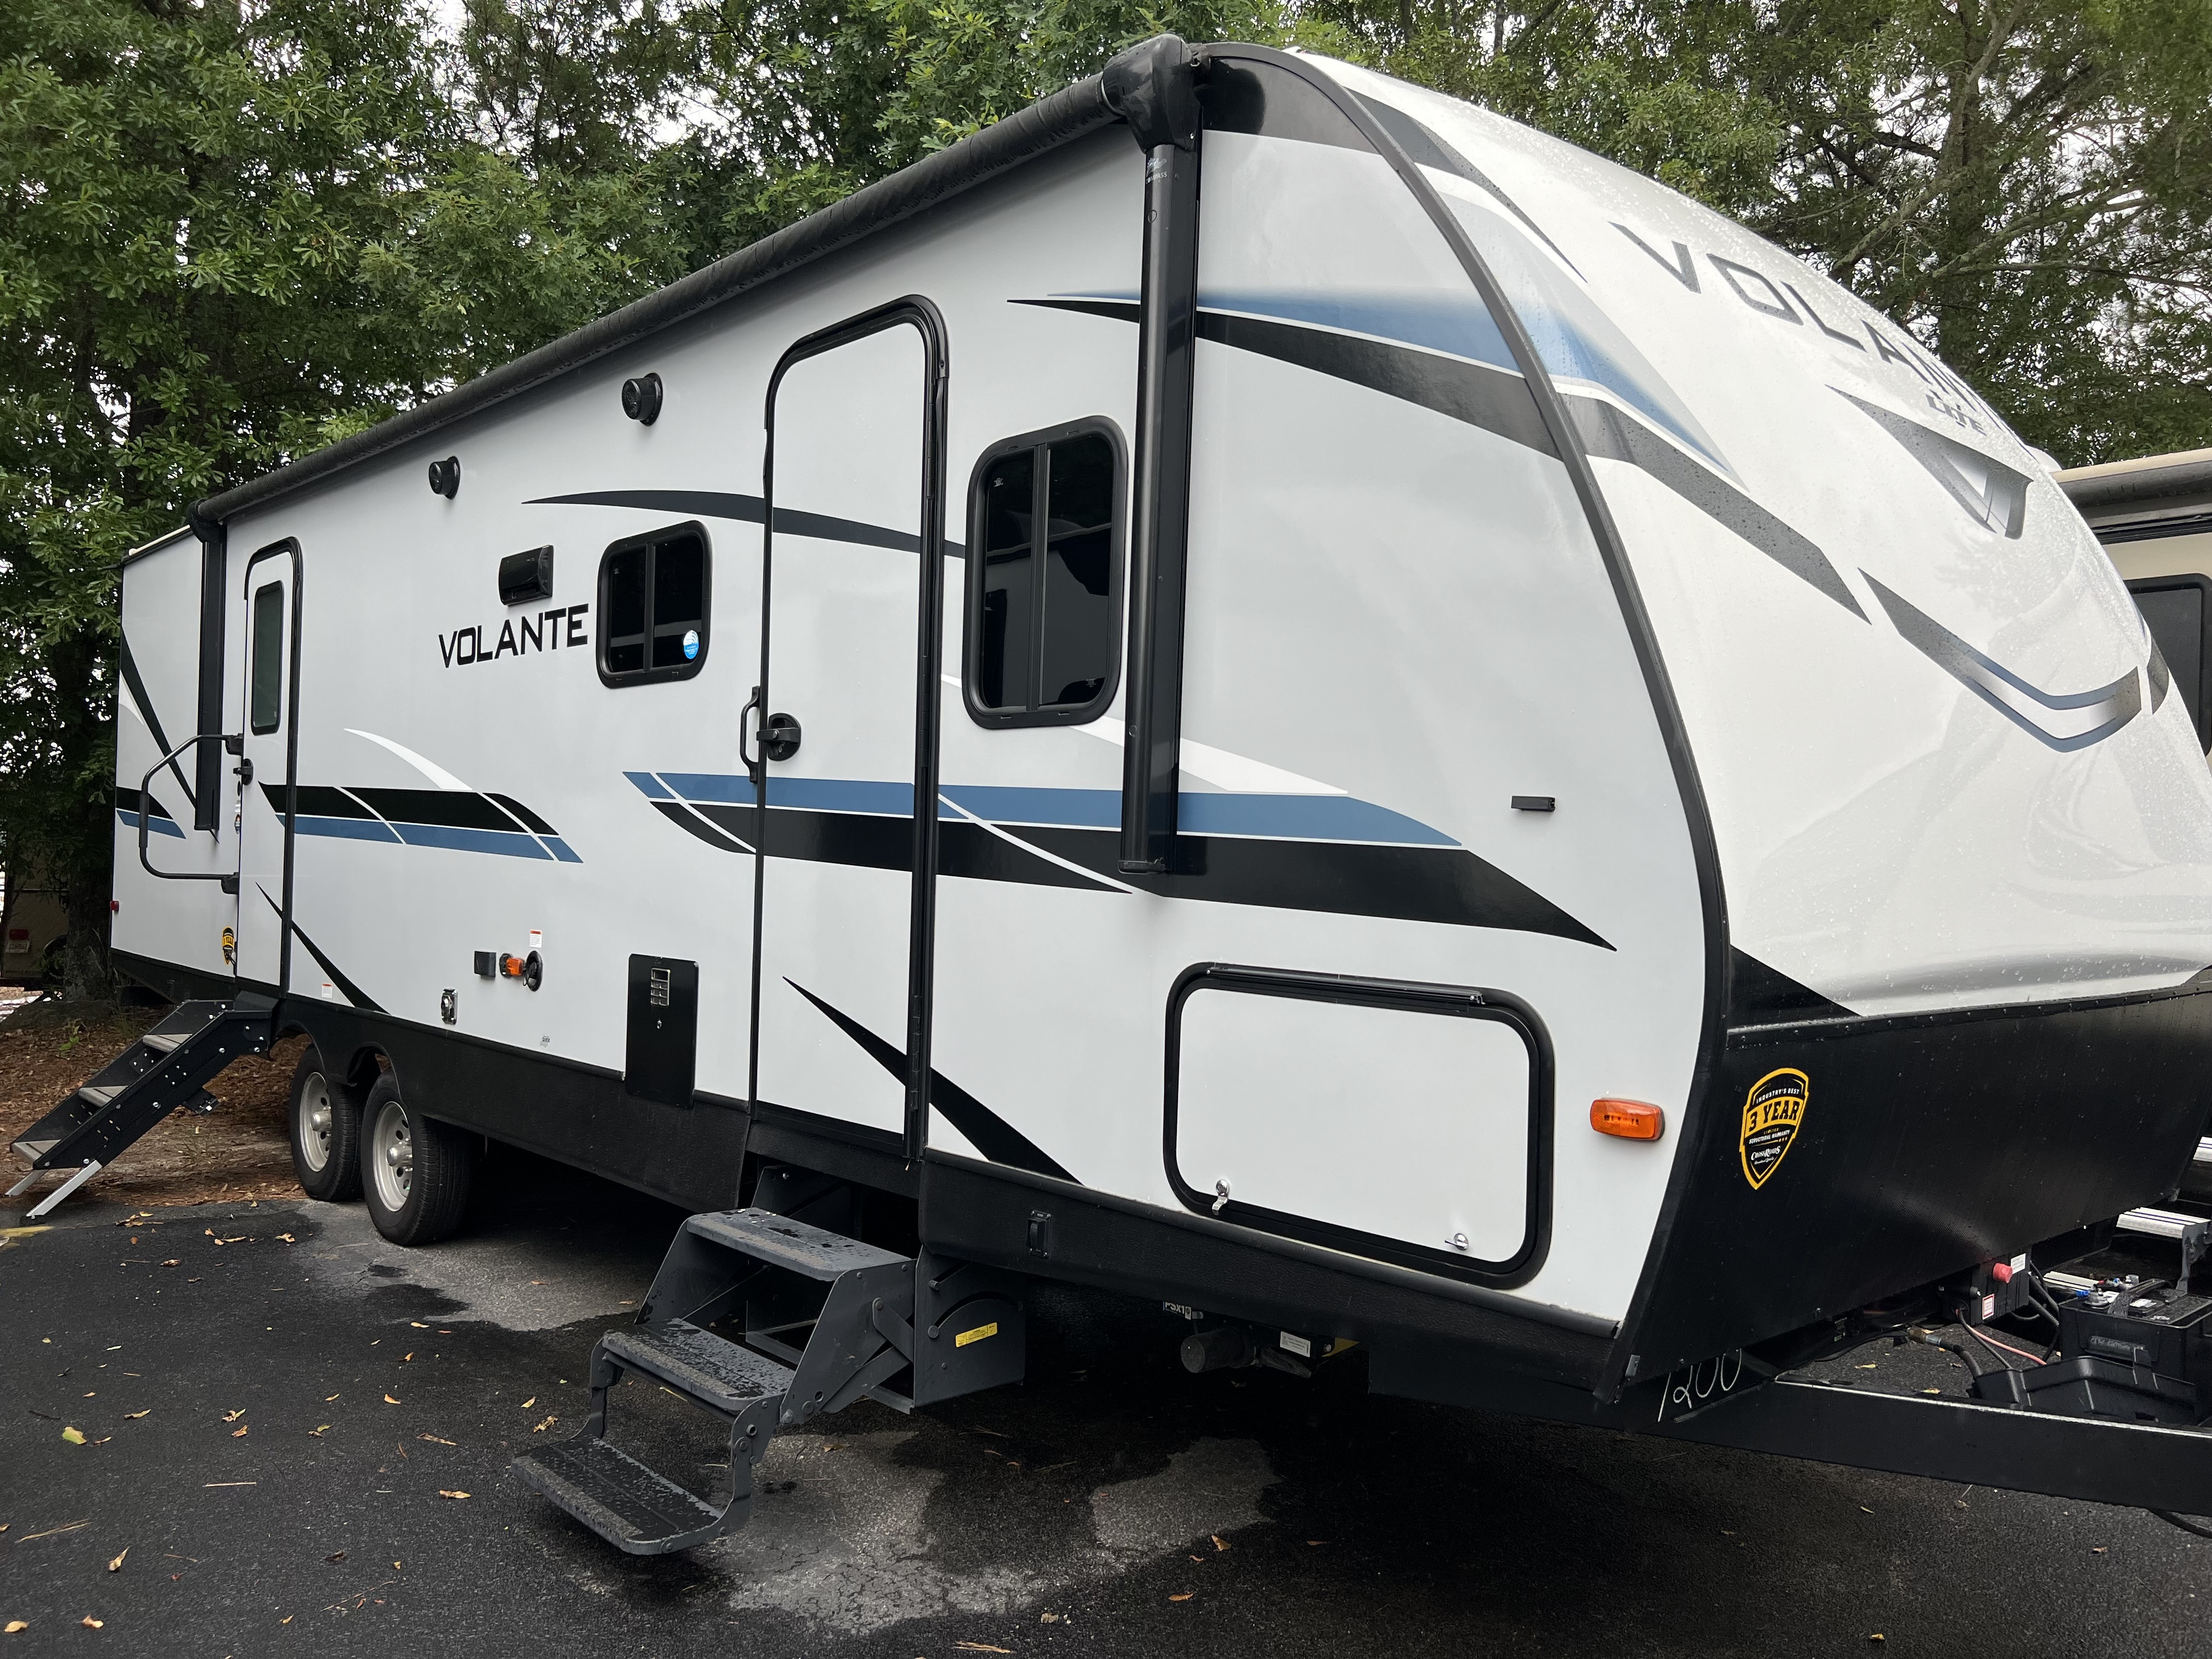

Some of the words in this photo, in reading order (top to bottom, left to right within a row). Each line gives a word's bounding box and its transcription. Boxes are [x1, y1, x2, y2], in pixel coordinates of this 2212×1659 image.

[438, 603, 589, 668] VOLANTE
[1756, 1088, 1787, 1104] INDUSTRY'S
[1748, 1111, 1758, 1132] 3
[1763, 1100, 1800, 1124] YEAR
